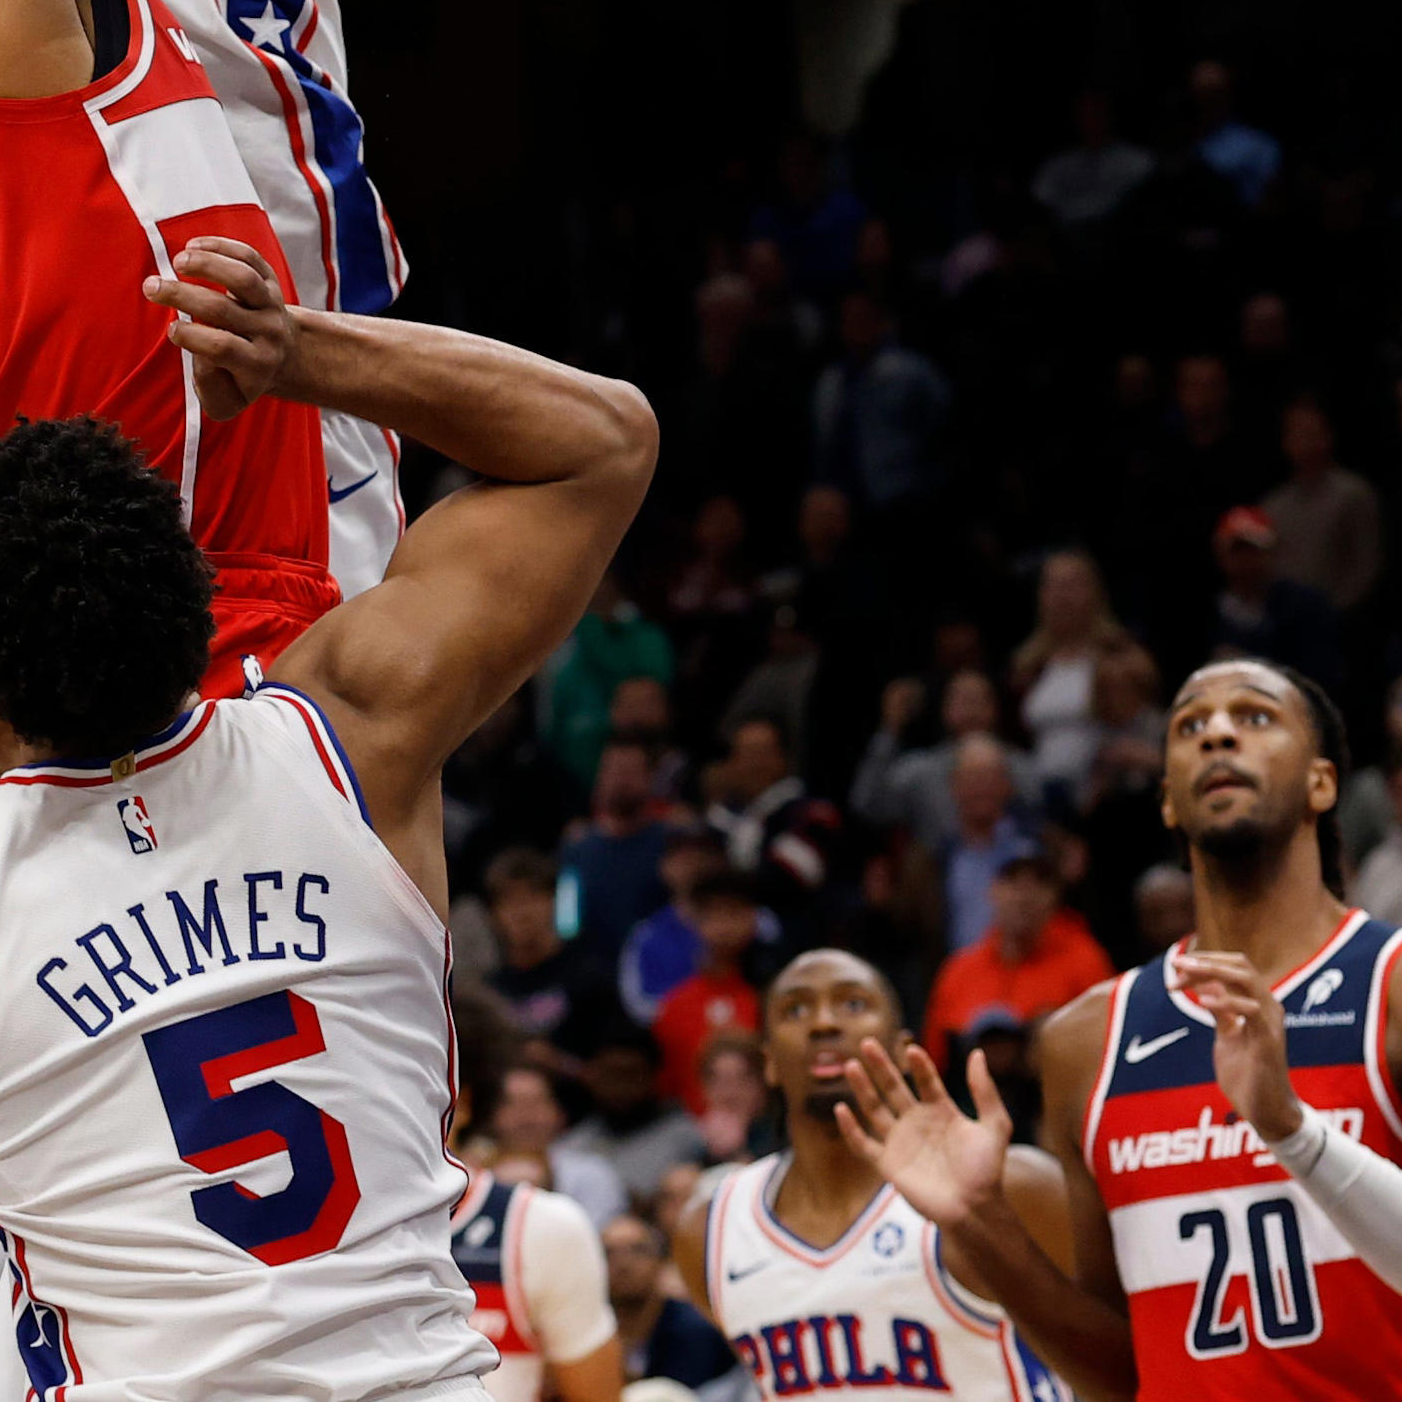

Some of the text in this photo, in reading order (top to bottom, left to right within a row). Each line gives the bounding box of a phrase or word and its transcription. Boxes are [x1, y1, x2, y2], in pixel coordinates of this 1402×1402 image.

[36, 870, 330, 1038] GRIMES
[142, 989, 361, 1266] 5
[1179, 1198, 1324, 1362] 20
